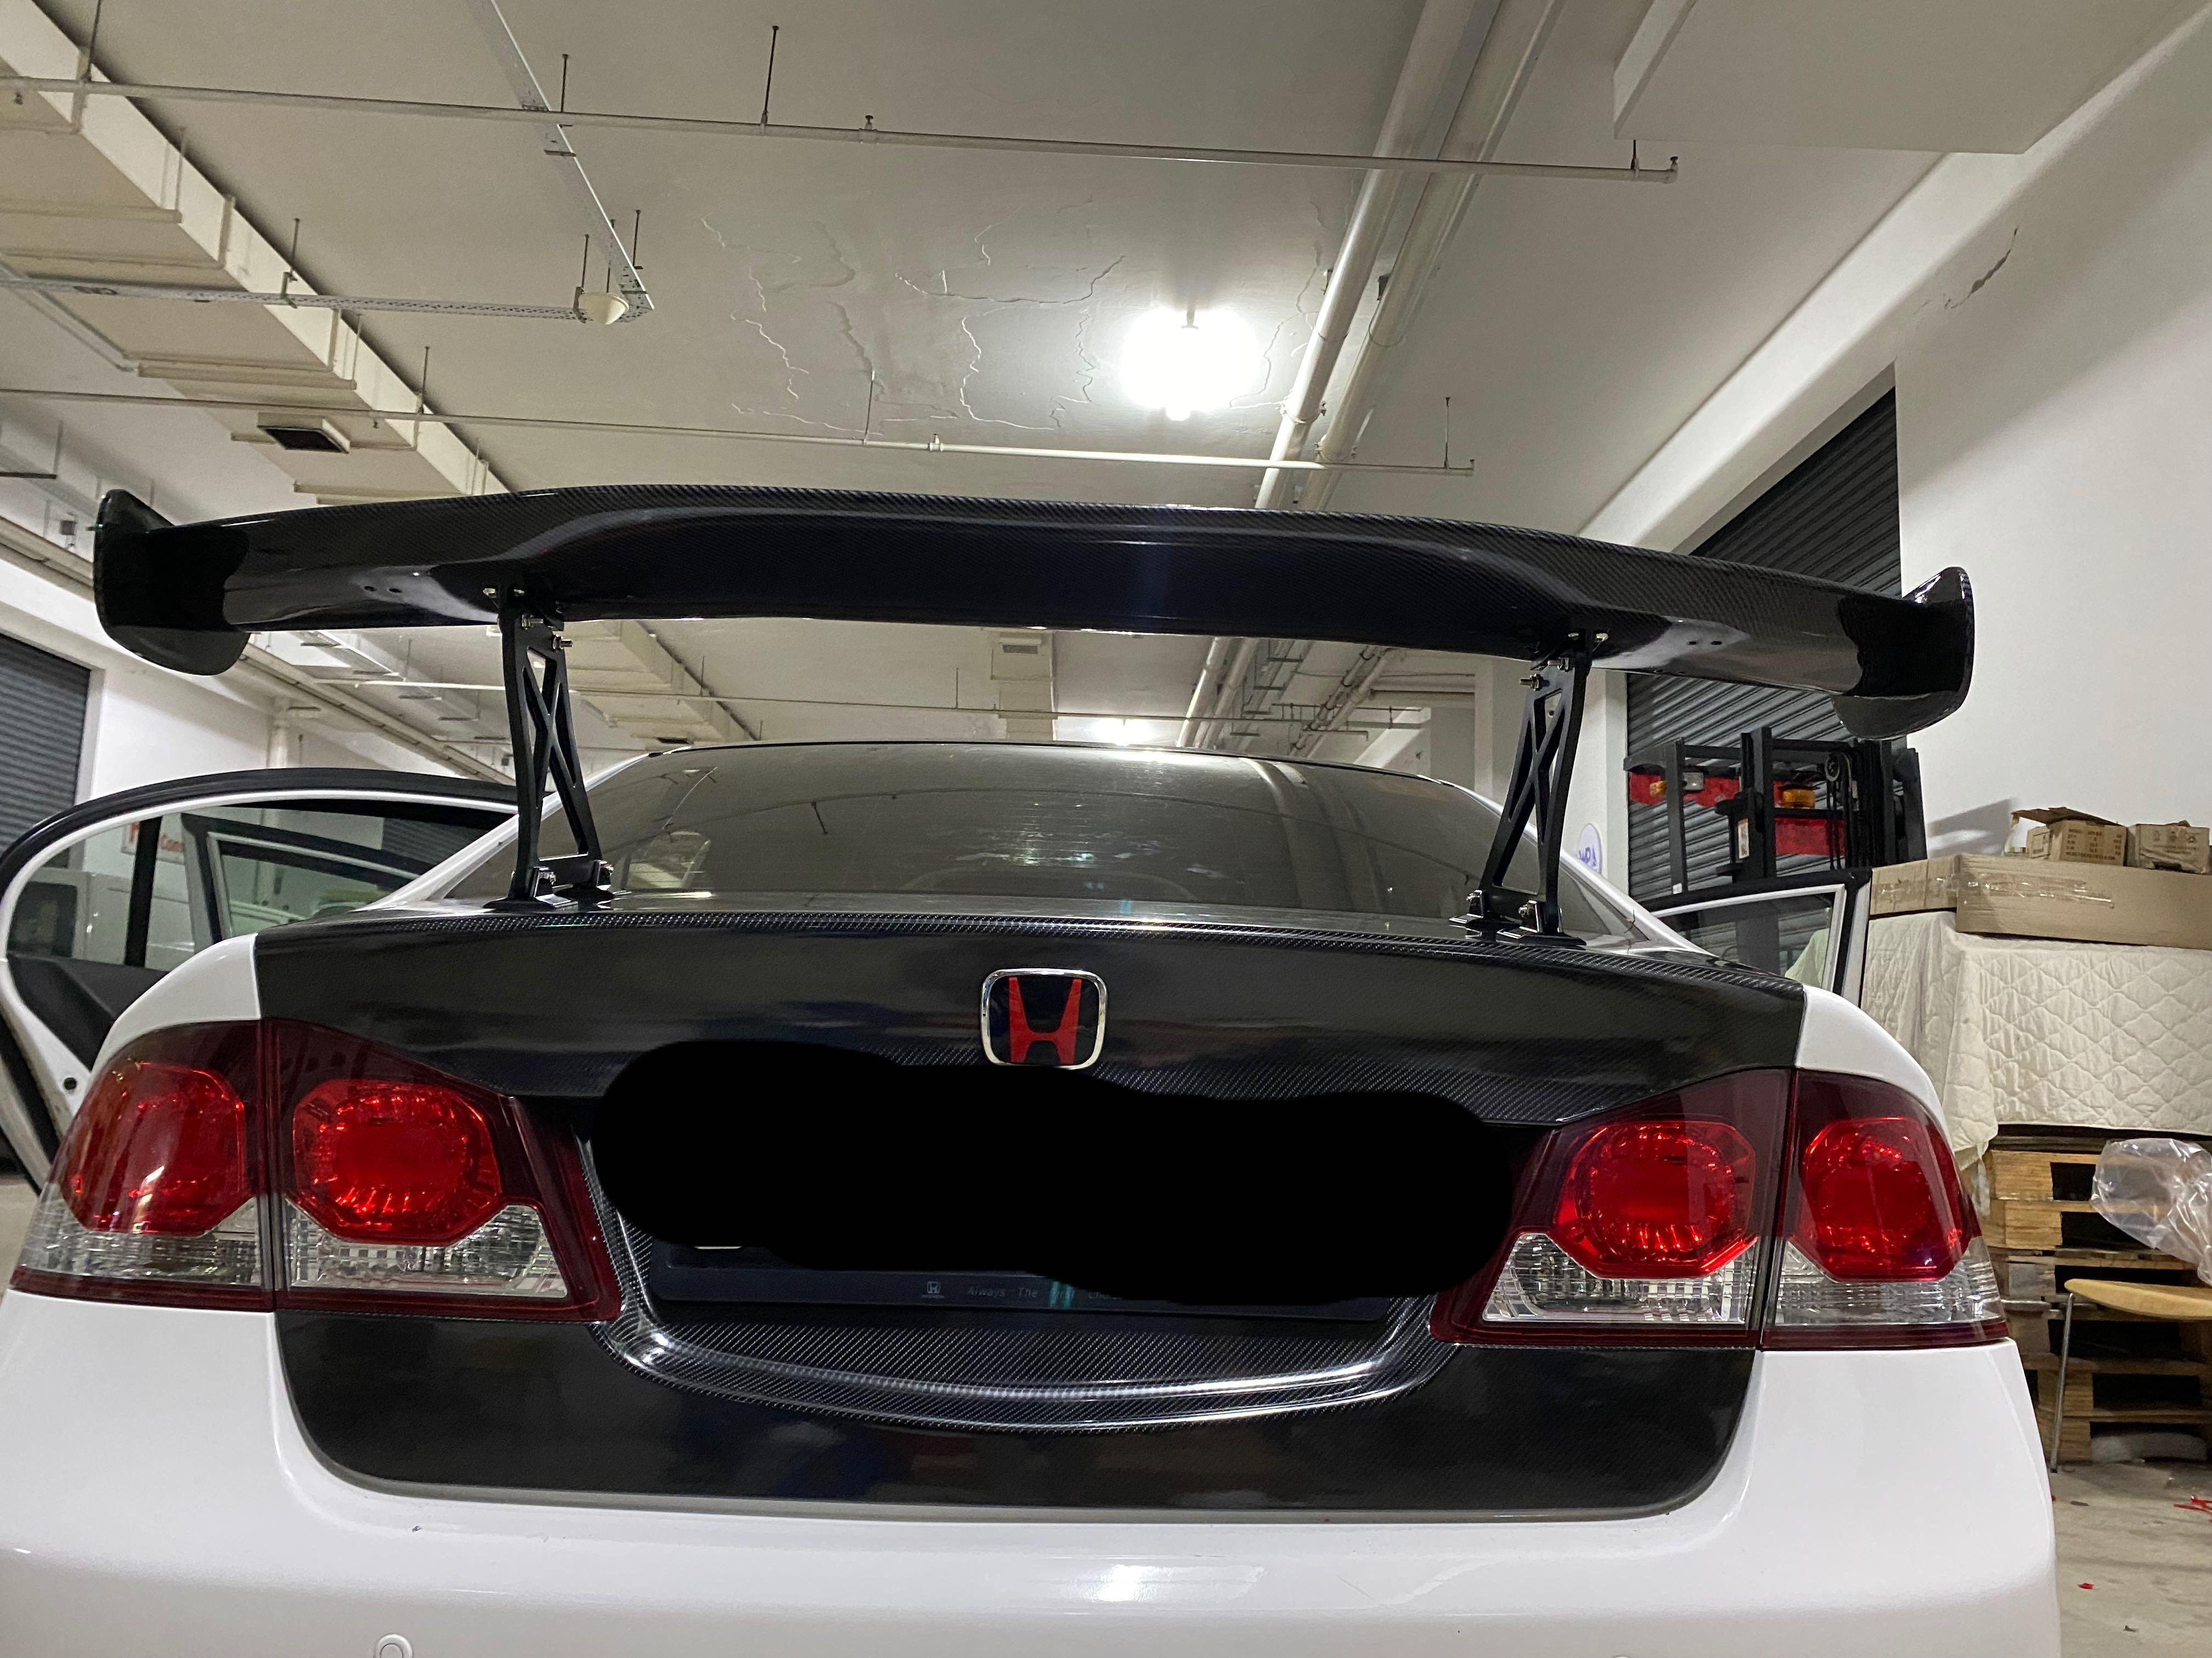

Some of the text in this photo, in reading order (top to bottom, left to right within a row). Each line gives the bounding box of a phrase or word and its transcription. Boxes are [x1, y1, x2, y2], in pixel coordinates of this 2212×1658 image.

[1008, 977, 1082, 1065] H
[966, 1286, 1006, 1299] Always
[1018, 1287, 1039, 1298] The
